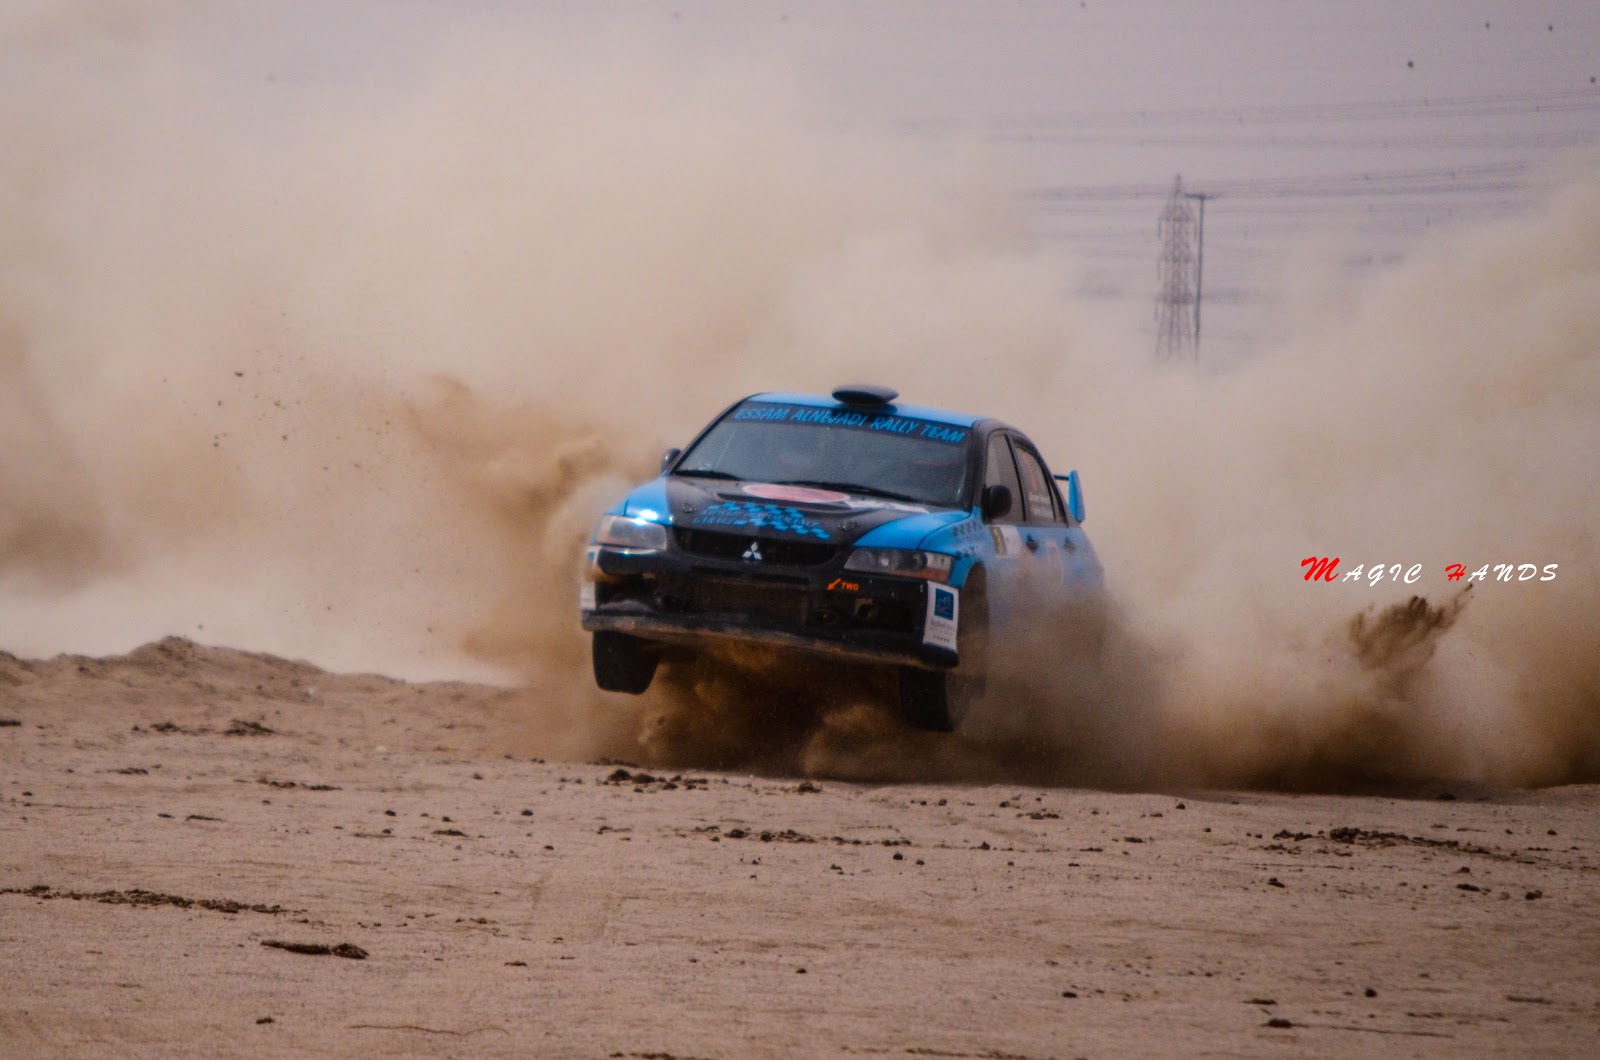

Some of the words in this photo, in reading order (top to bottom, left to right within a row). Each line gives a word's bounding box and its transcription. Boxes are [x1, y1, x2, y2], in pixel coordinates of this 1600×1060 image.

[735, 408, 789, 420] ESSAM
[871, 416, 918, 434] RALLY
[920, 424, 965, 444] TEAM
[841, 582, 860, 591] TWO
